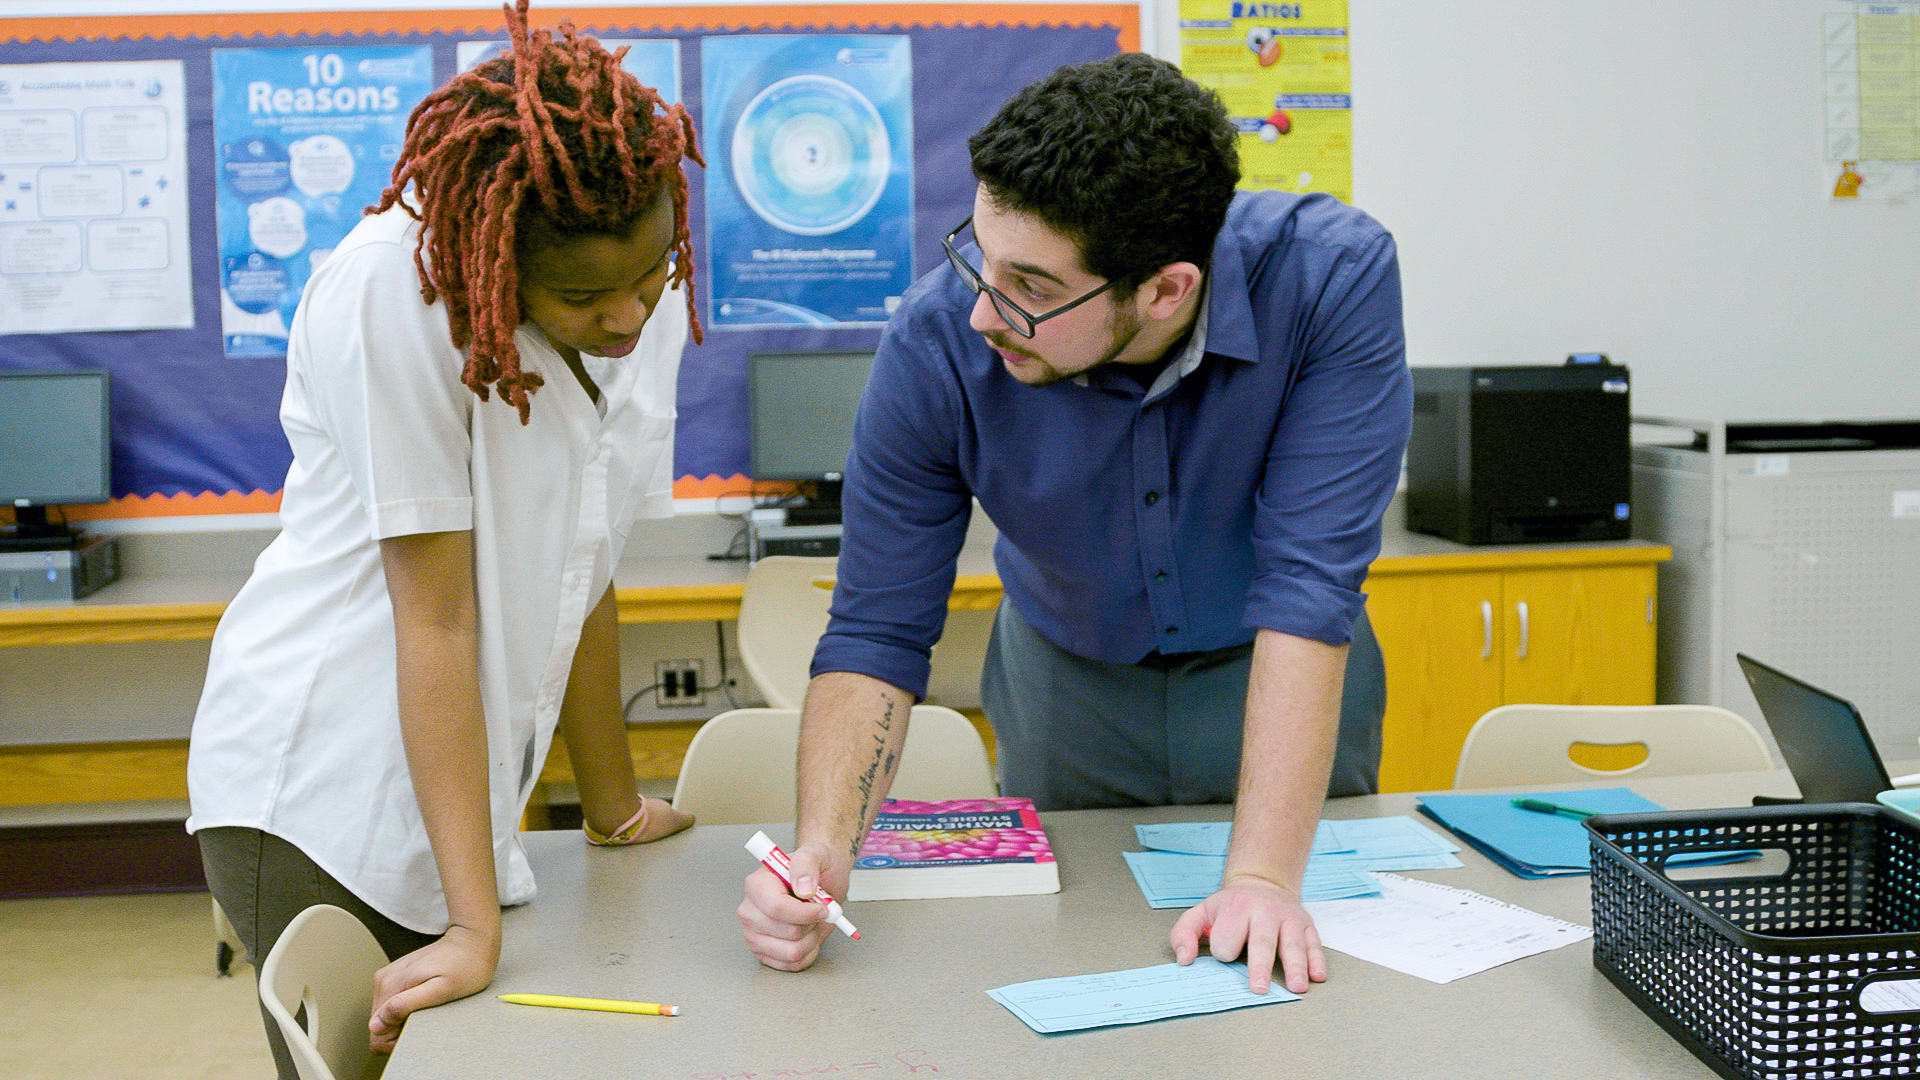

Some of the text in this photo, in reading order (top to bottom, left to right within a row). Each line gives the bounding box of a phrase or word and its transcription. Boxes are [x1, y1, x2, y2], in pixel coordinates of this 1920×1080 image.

[303, 54, 344, 86] 10
[248, 81, 399, 114] Reasons
[871, 820, 1013, 831] MATHEMATICA
[937, 815, 1011, 823] STUDIES
